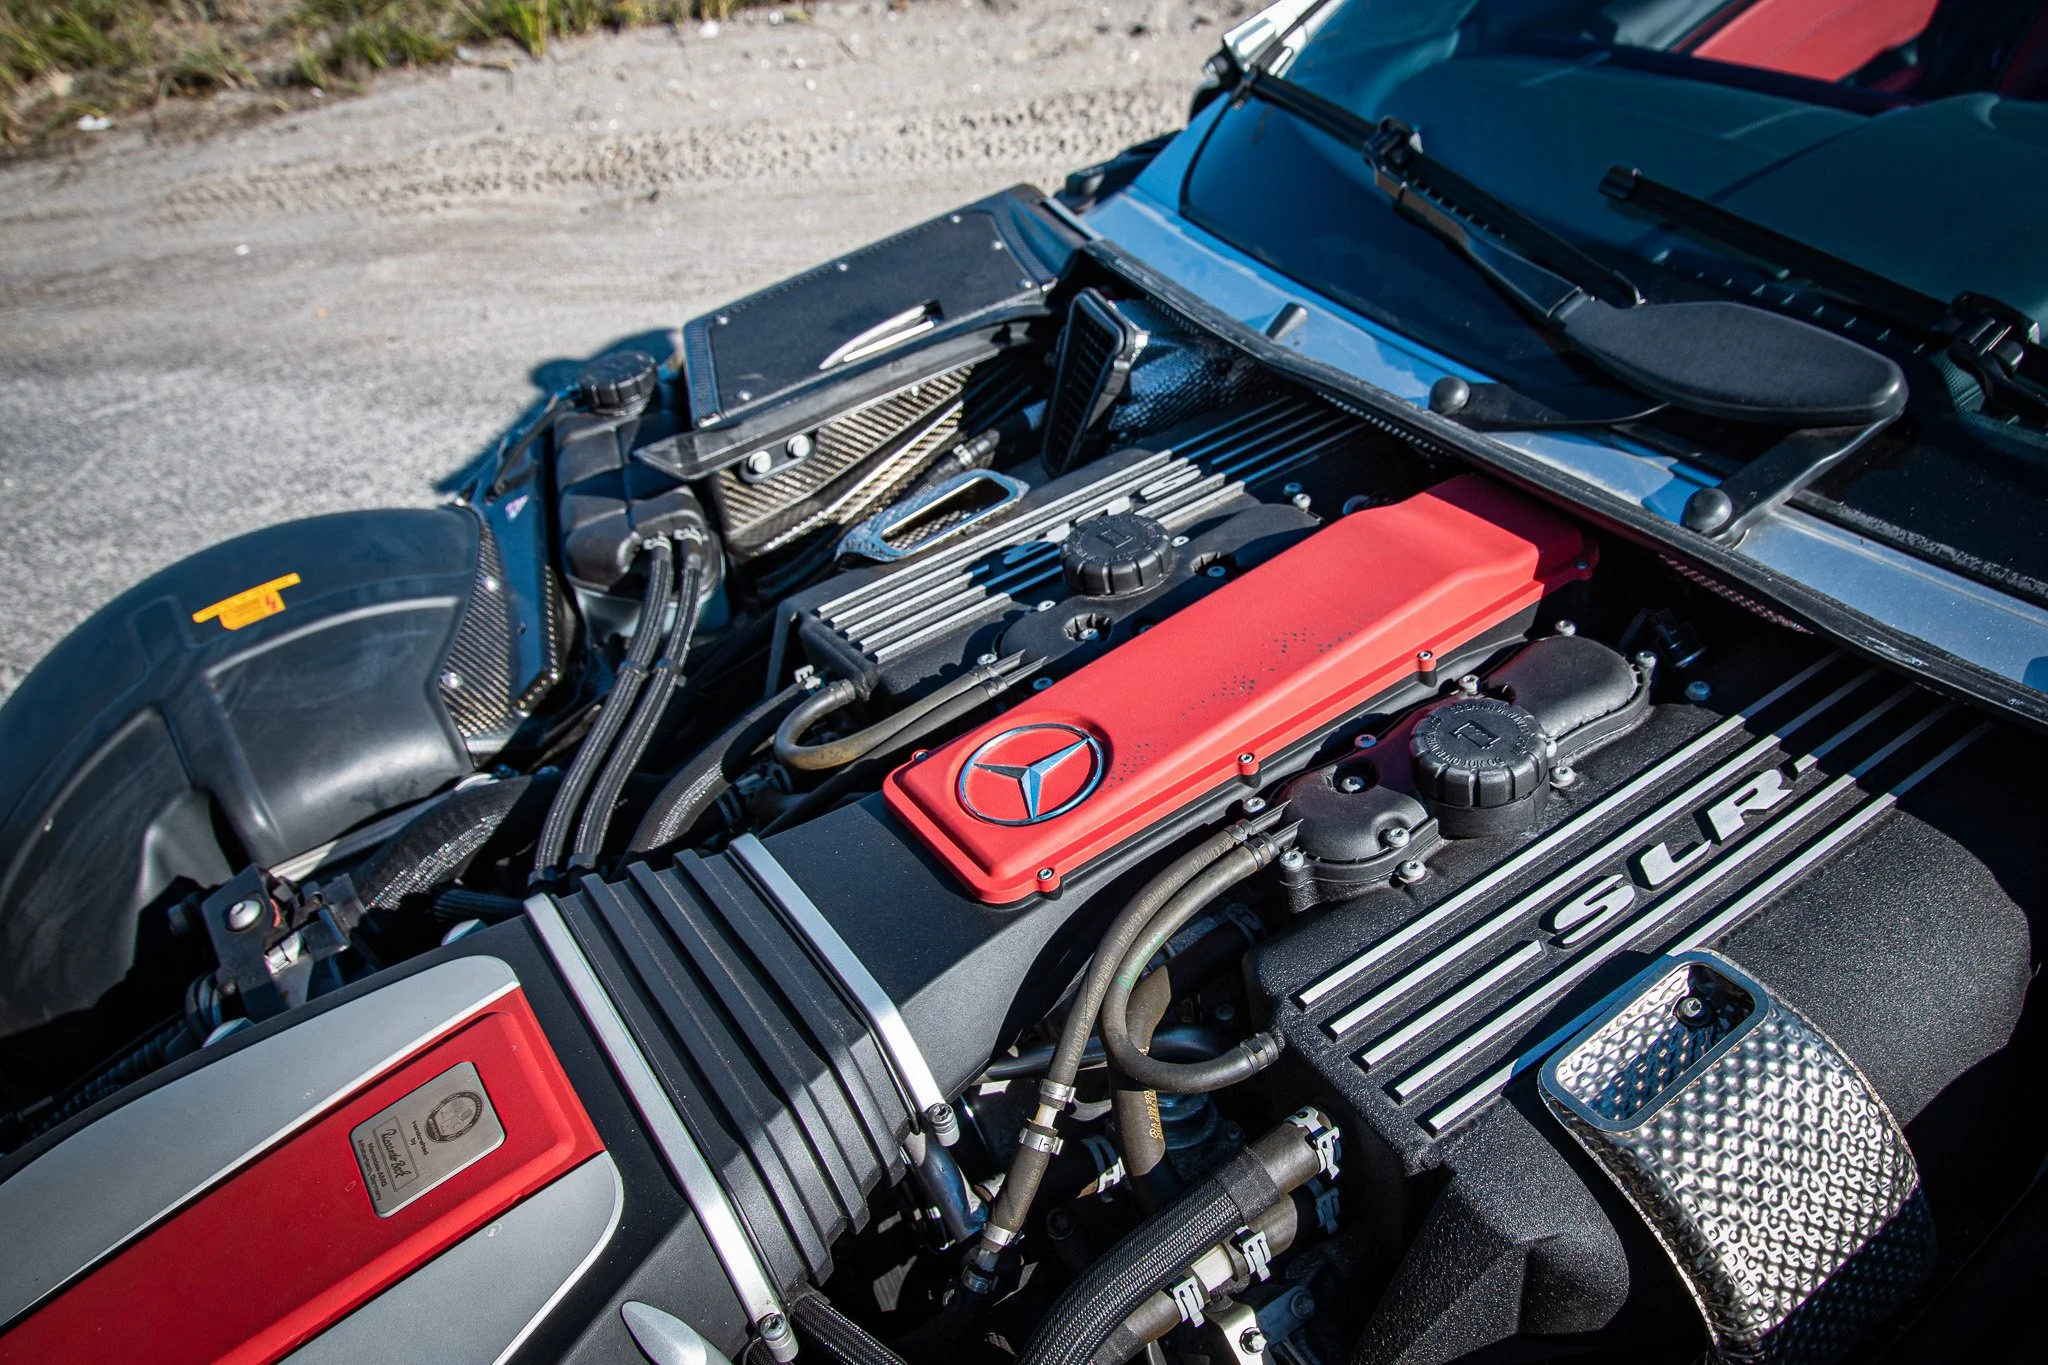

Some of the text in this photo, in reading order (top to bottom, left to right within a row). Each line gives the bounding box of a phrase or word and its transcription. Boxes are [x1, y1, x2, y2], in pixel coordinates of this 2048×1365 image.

[1462, 759, 1485, 768] NOT
[1554, 769, 1794, 945] SLR
[410, 1137, 417, 1146] by
[411, 1120, 429, 1156] Handcrafted
[367, 1142, 387, 1188] Mercedes-AMG
[370, 1174, 382, 1201] Germany
